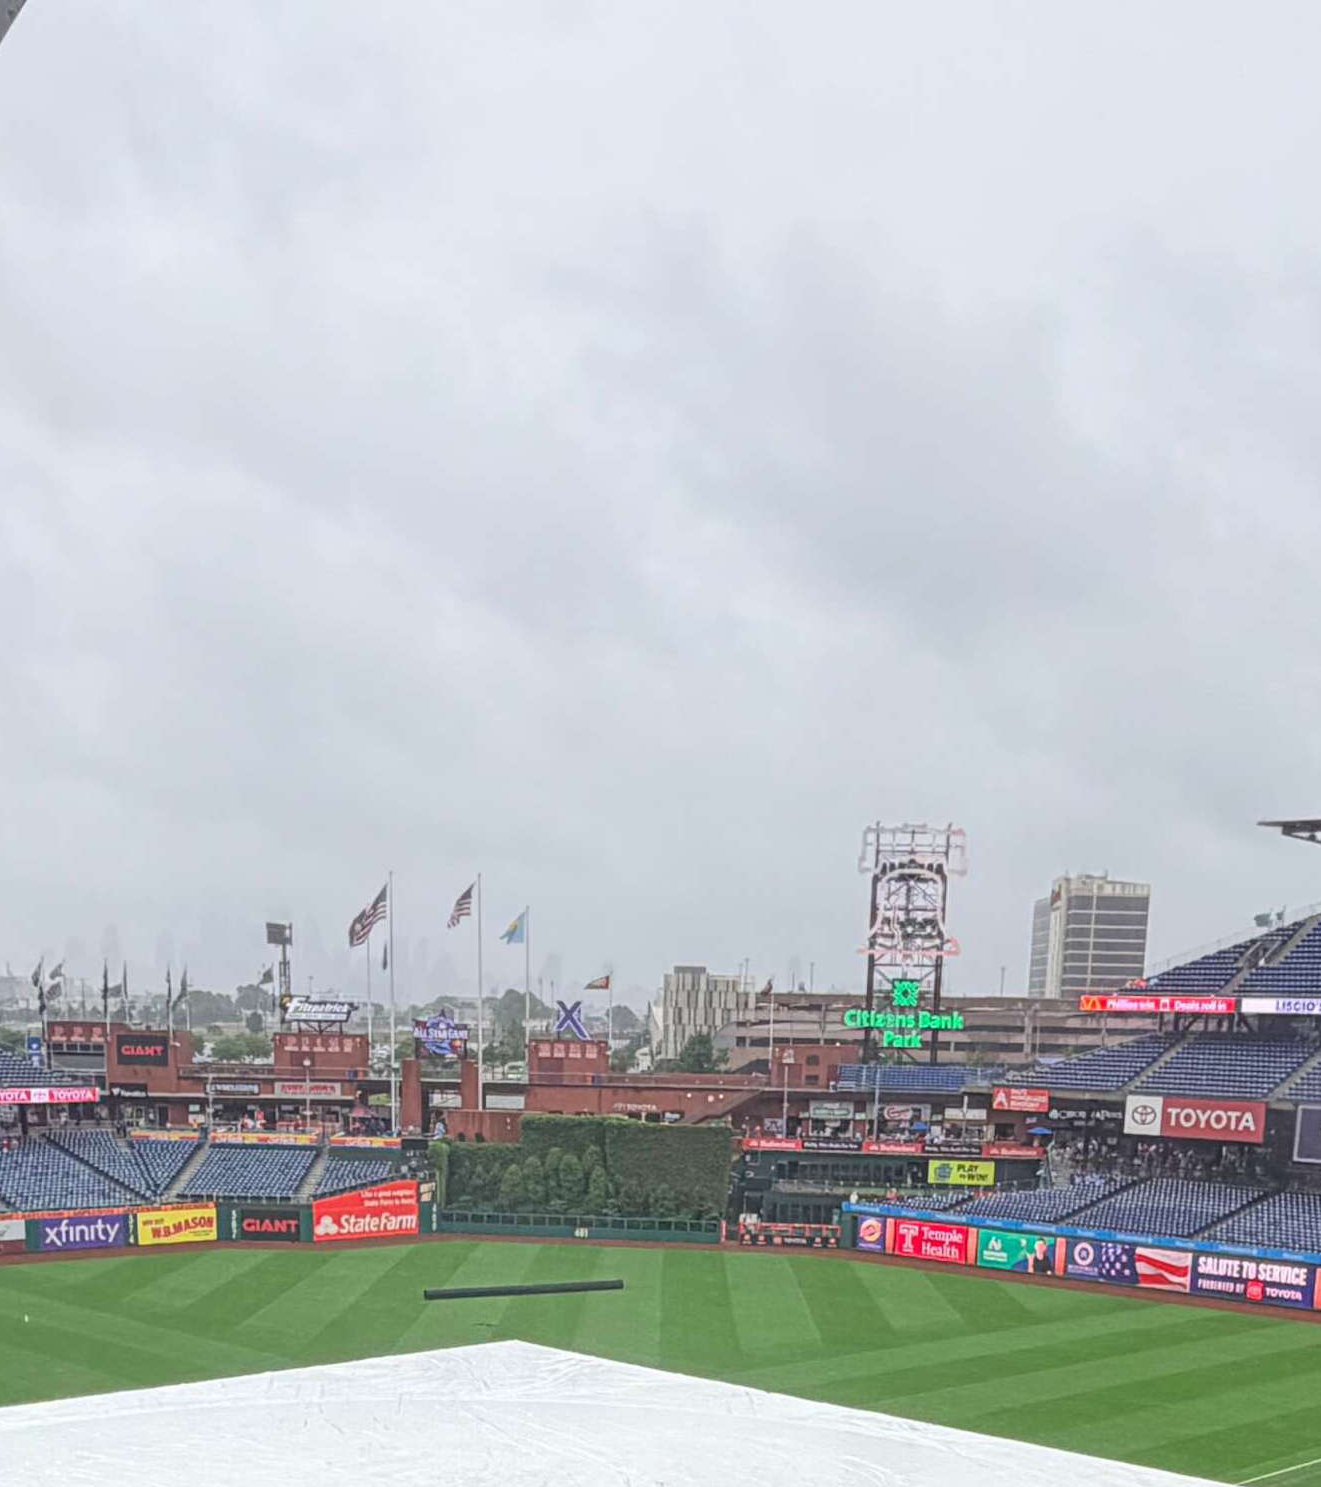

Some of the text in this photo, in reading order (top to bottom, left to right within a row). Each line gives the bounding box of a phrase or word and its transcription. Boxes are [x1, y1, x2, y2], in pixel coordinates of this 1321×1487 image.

[844, 1008, 963, 1030] Citizens Bank
[883, 1030, 923, 1048] Park
[121, 1045, 164, 1056] GIANT
[52, 1089, 95, 1100] TOYOTA
[1167, 1108, 1256, 1131] TOYOTA
[45, 1219, 120, 1247] xfinity
[242, 1219, 298, 1232] GIANT
[921, 1227, 963, 1243] Temple
[921, 1241, 959, 1259] Health
[1197, 1256, 1308, 1286] SALUTE TO SERVICE
[1265, 1287, 1302, 1301] TOYOTA
